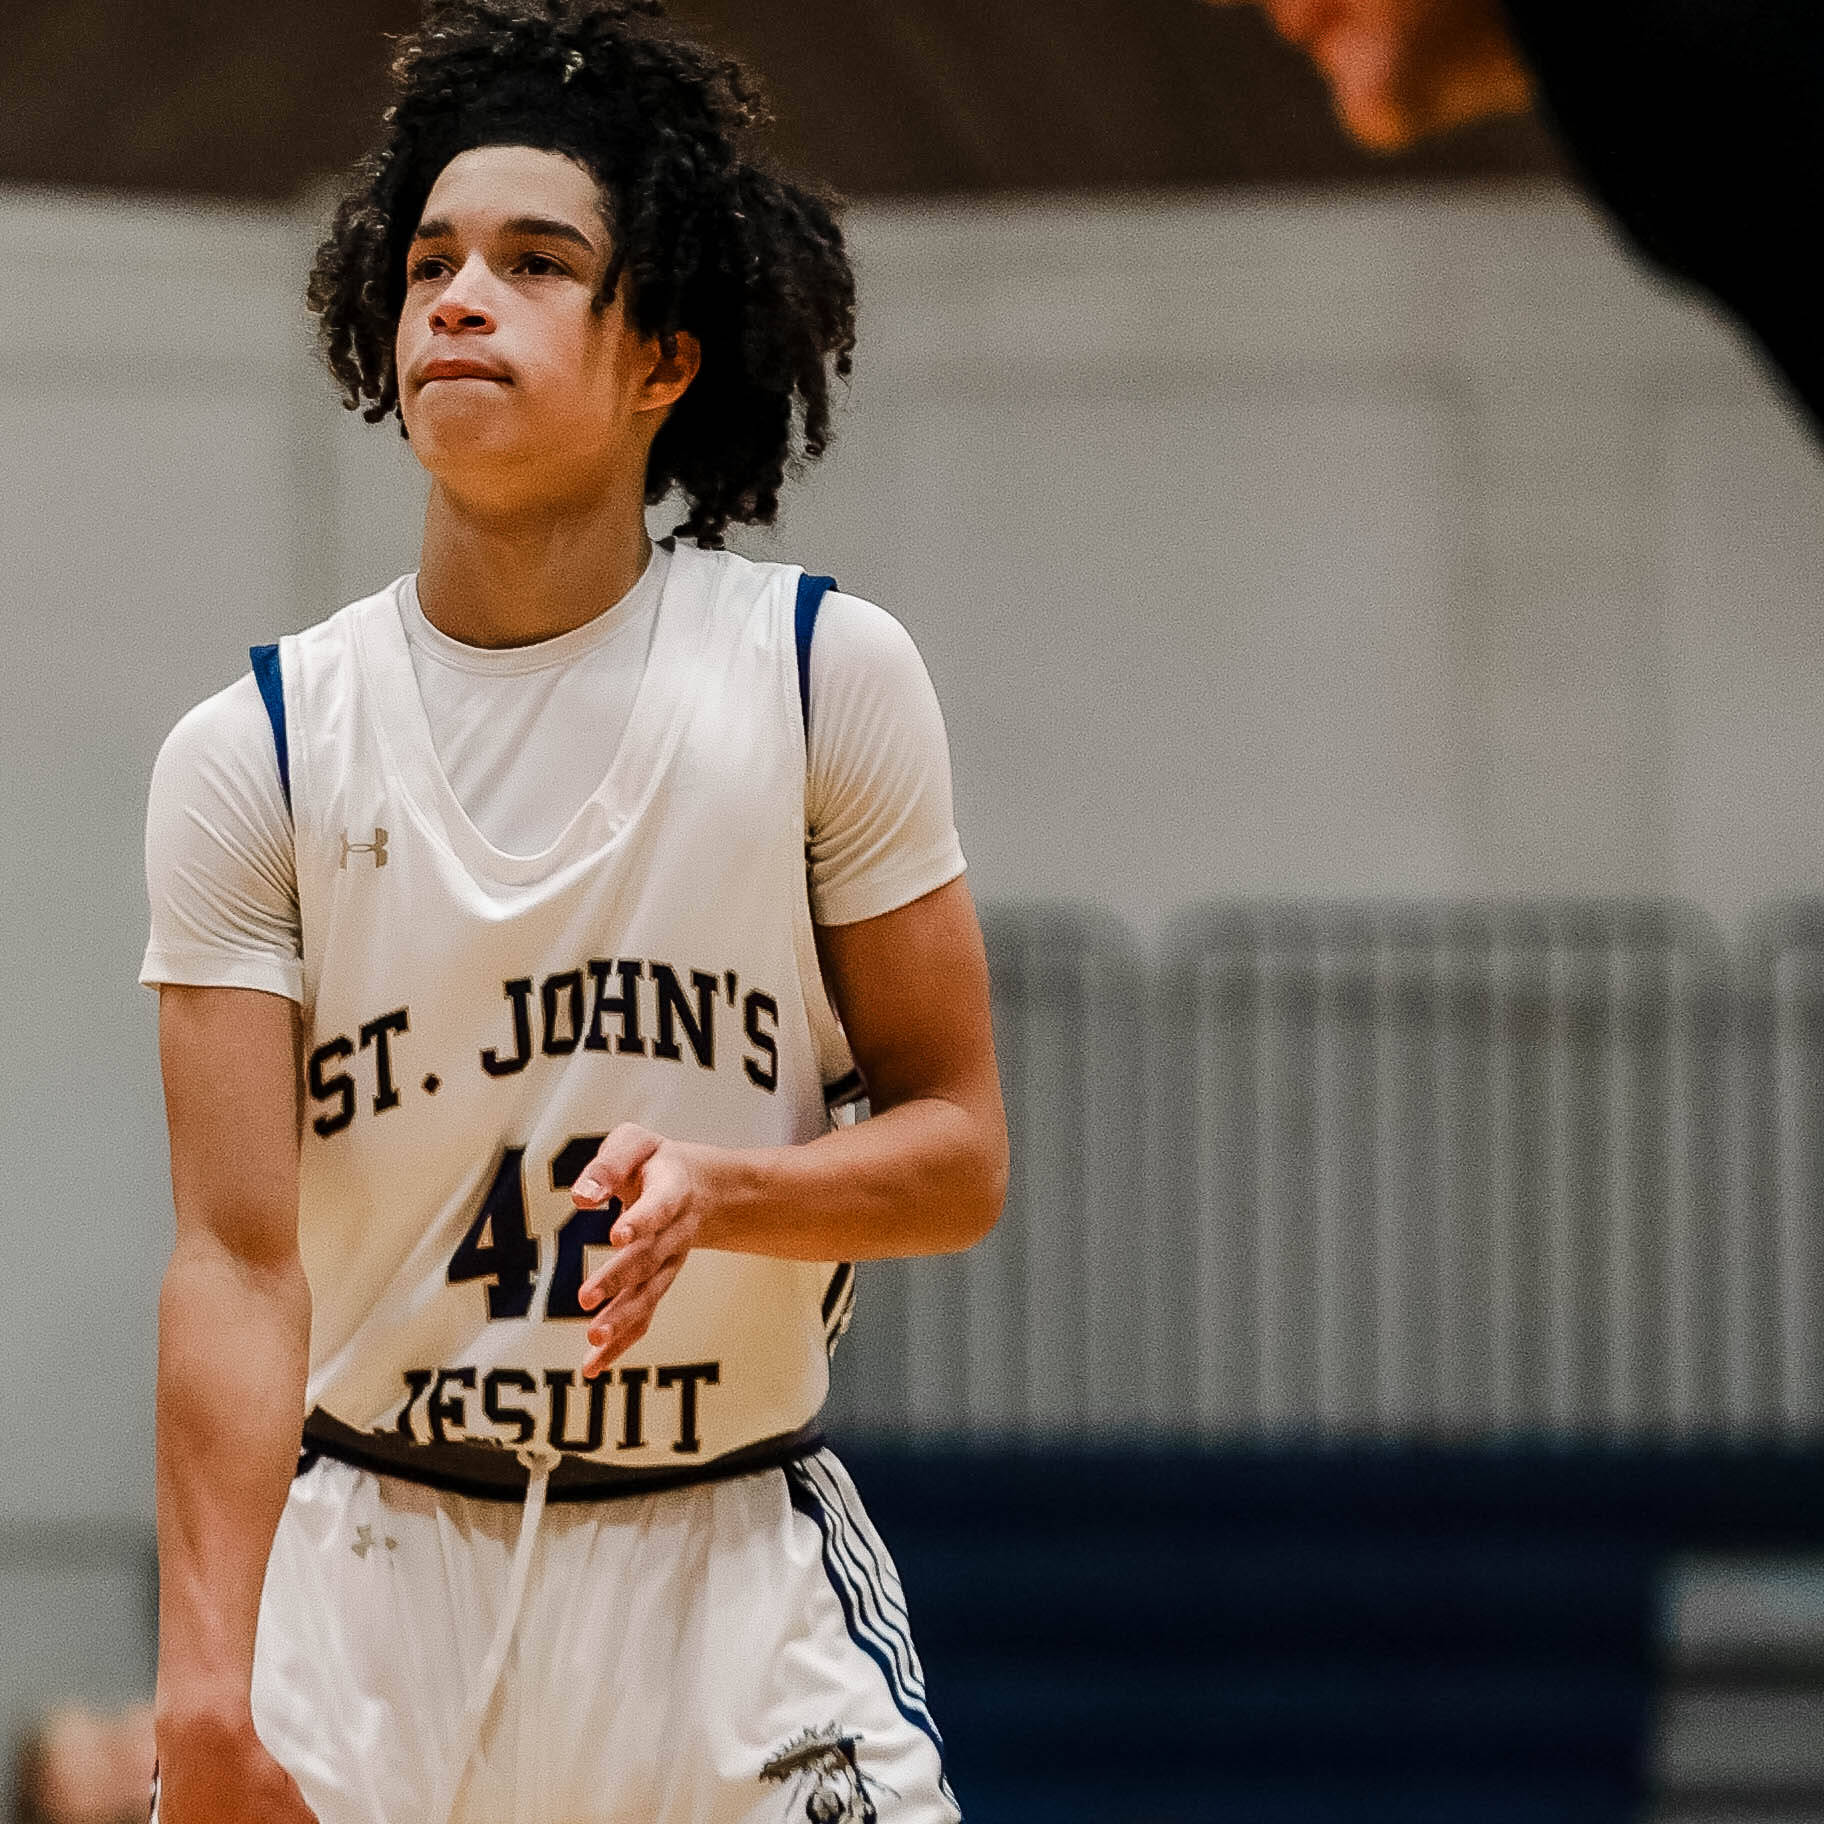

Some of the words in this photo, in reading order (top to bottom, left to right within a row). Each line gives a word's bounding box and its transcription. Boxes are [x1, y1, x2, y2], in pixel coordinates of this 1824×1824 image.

[309, 1007, 442, 1138] ST.
[481, 959, 779, 1094] JOHN'S
[447, 1134, 623, 1322] 42
